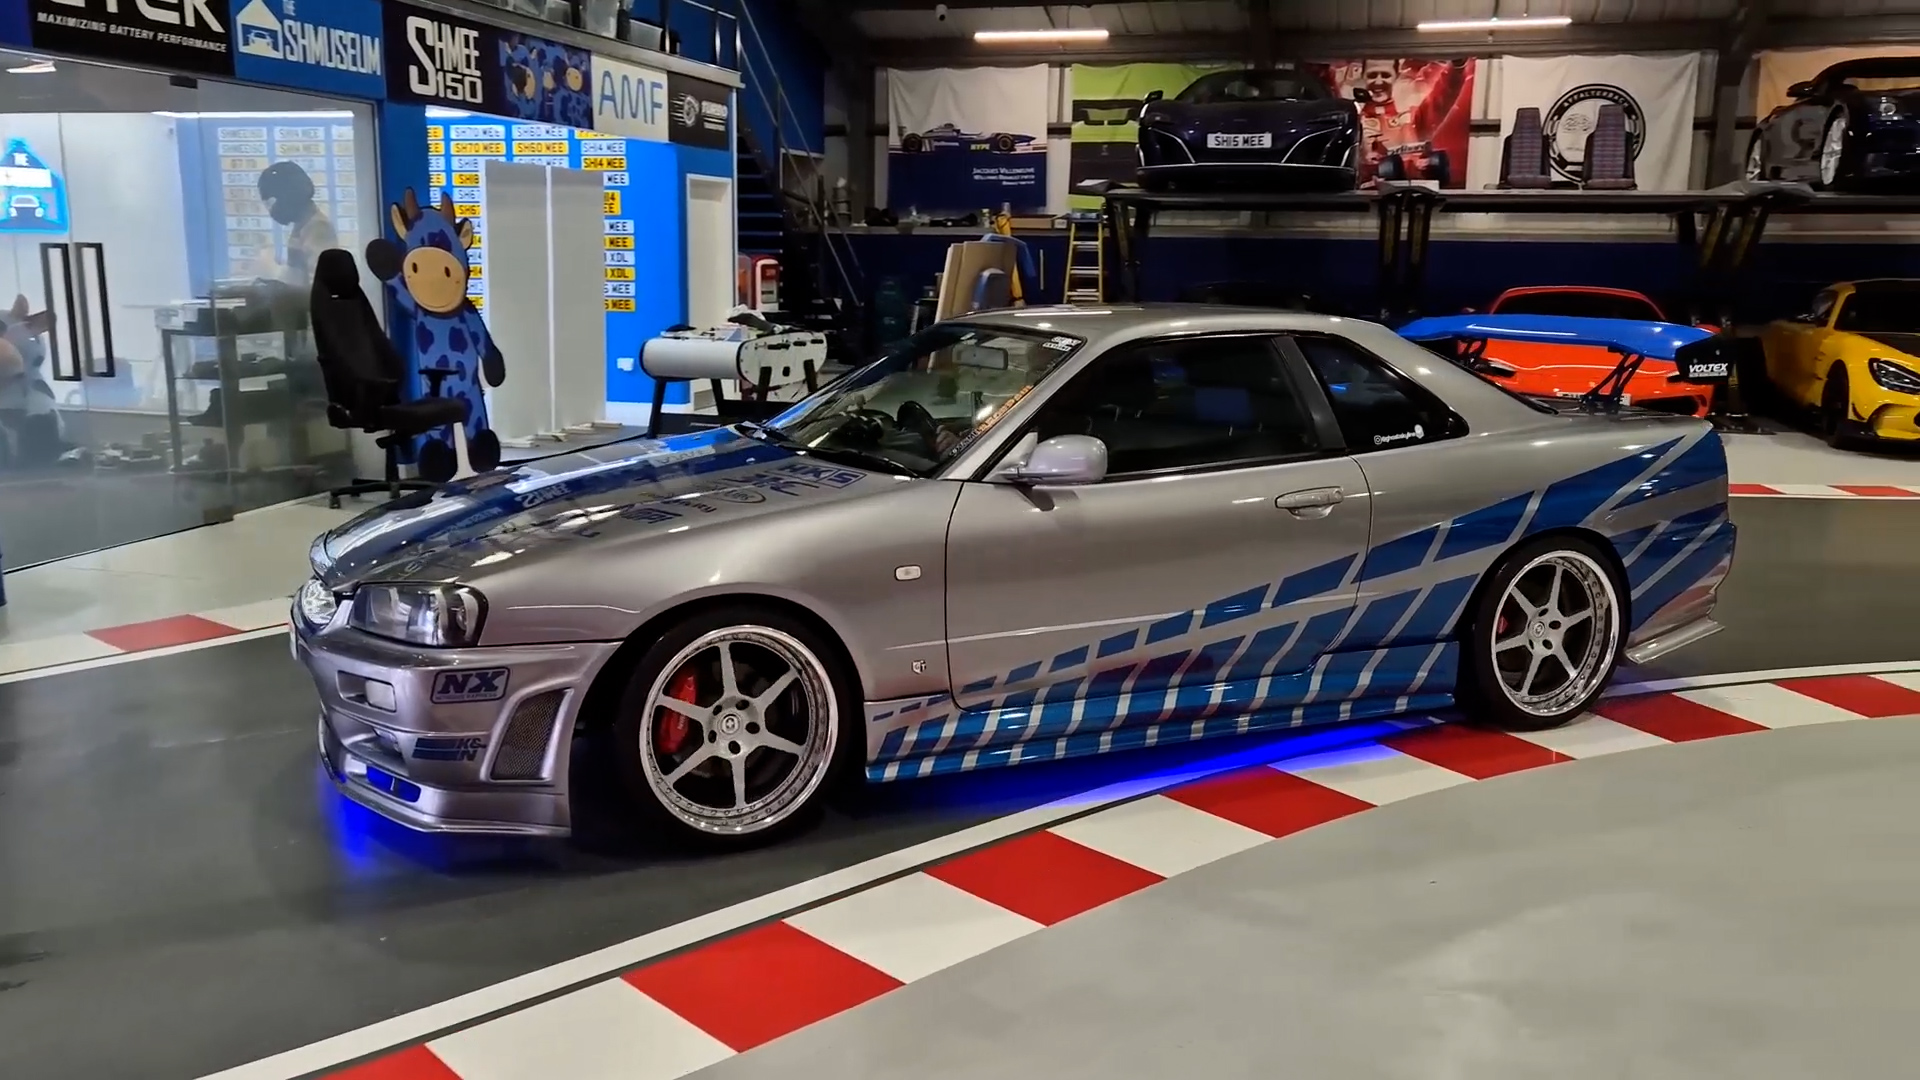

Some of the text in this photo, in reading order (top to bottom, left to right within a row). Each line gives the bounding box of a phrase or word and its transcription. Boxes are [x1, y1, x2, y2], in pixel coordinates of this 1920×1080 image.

[37, 12, 226, 53] MAXIMIZING BATTERY PERFORMANCE
[283, 19, 381, 75] SHMUSEUM
[406, 16, 480, 96] SHMEE
[436, 72, 483, 103] 150
[599, 69, 663, 125] AMF
[1242, 135, 1265, 146] MEE
[482, 143, 501, 153] MEE
[545, 143, 564, 152] MEE
[606, 143, 624, 152] MEE
[607, 158, 625, 168] MEE
[607, 173, 626, 183] MEE
[609, 222, 628, 231] MEE
[609, 237, 628, 247] MEE
[610, 253, 629, 262] XDL
[610, 268, 629, 278] XDL
[612, 284, 631, 293] MEE
[611, 300, 631, 309] MEE
[1689, 363, 1728, 373] VOLTEX
[437, 670, 506, 695] NX
